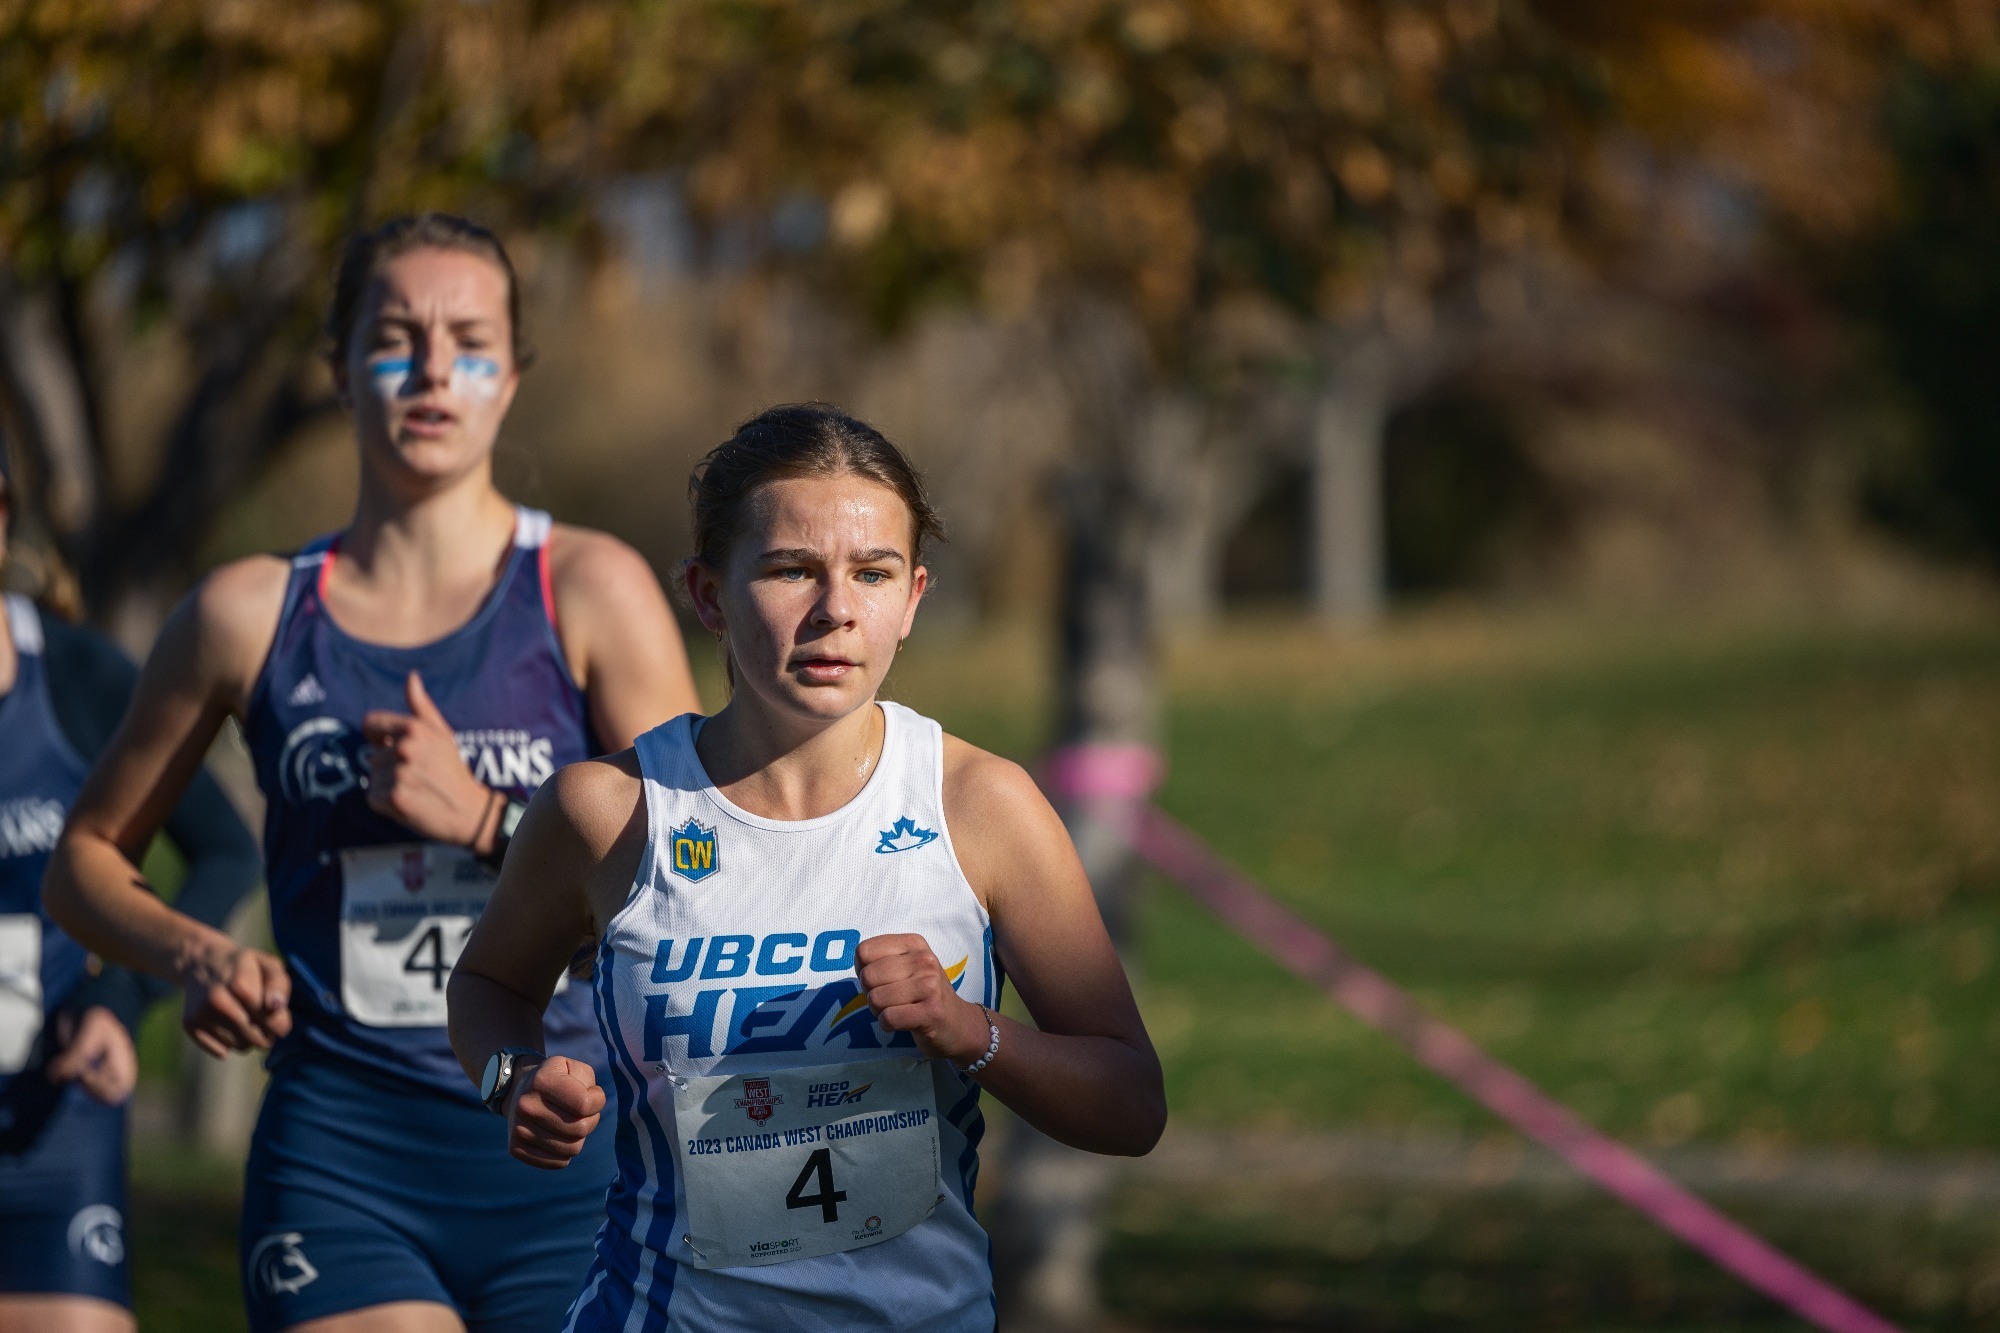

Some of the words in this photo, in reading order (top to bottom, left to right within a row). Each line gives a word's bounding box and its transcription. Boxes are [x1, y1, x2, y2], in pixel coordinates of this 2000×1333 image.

[675, 838, 714, 870] CW
[404, 924, 475, 992] 4
[650, 929, 861, 984] UBCO
[643, 975, 922, 1062] HEA
[747, 1088, 768, 1099] WEST
[807, 1088, 865, 1108] HEAT
[809, 1081, 850, 1093] UBCO
[687, 1139, 722, 1156] 2023
[726, 1132, 781, 1153] CANADA
[784, 1125, 823, 1147] WEST
[825, 1108, 930, 1141] CHAMPIONSHIP
[785, 1147, 848, 1224] 4
[749, 1238, 799, 1252] viaSPORT
[854, 1230, 883, 1240] Kelowna
